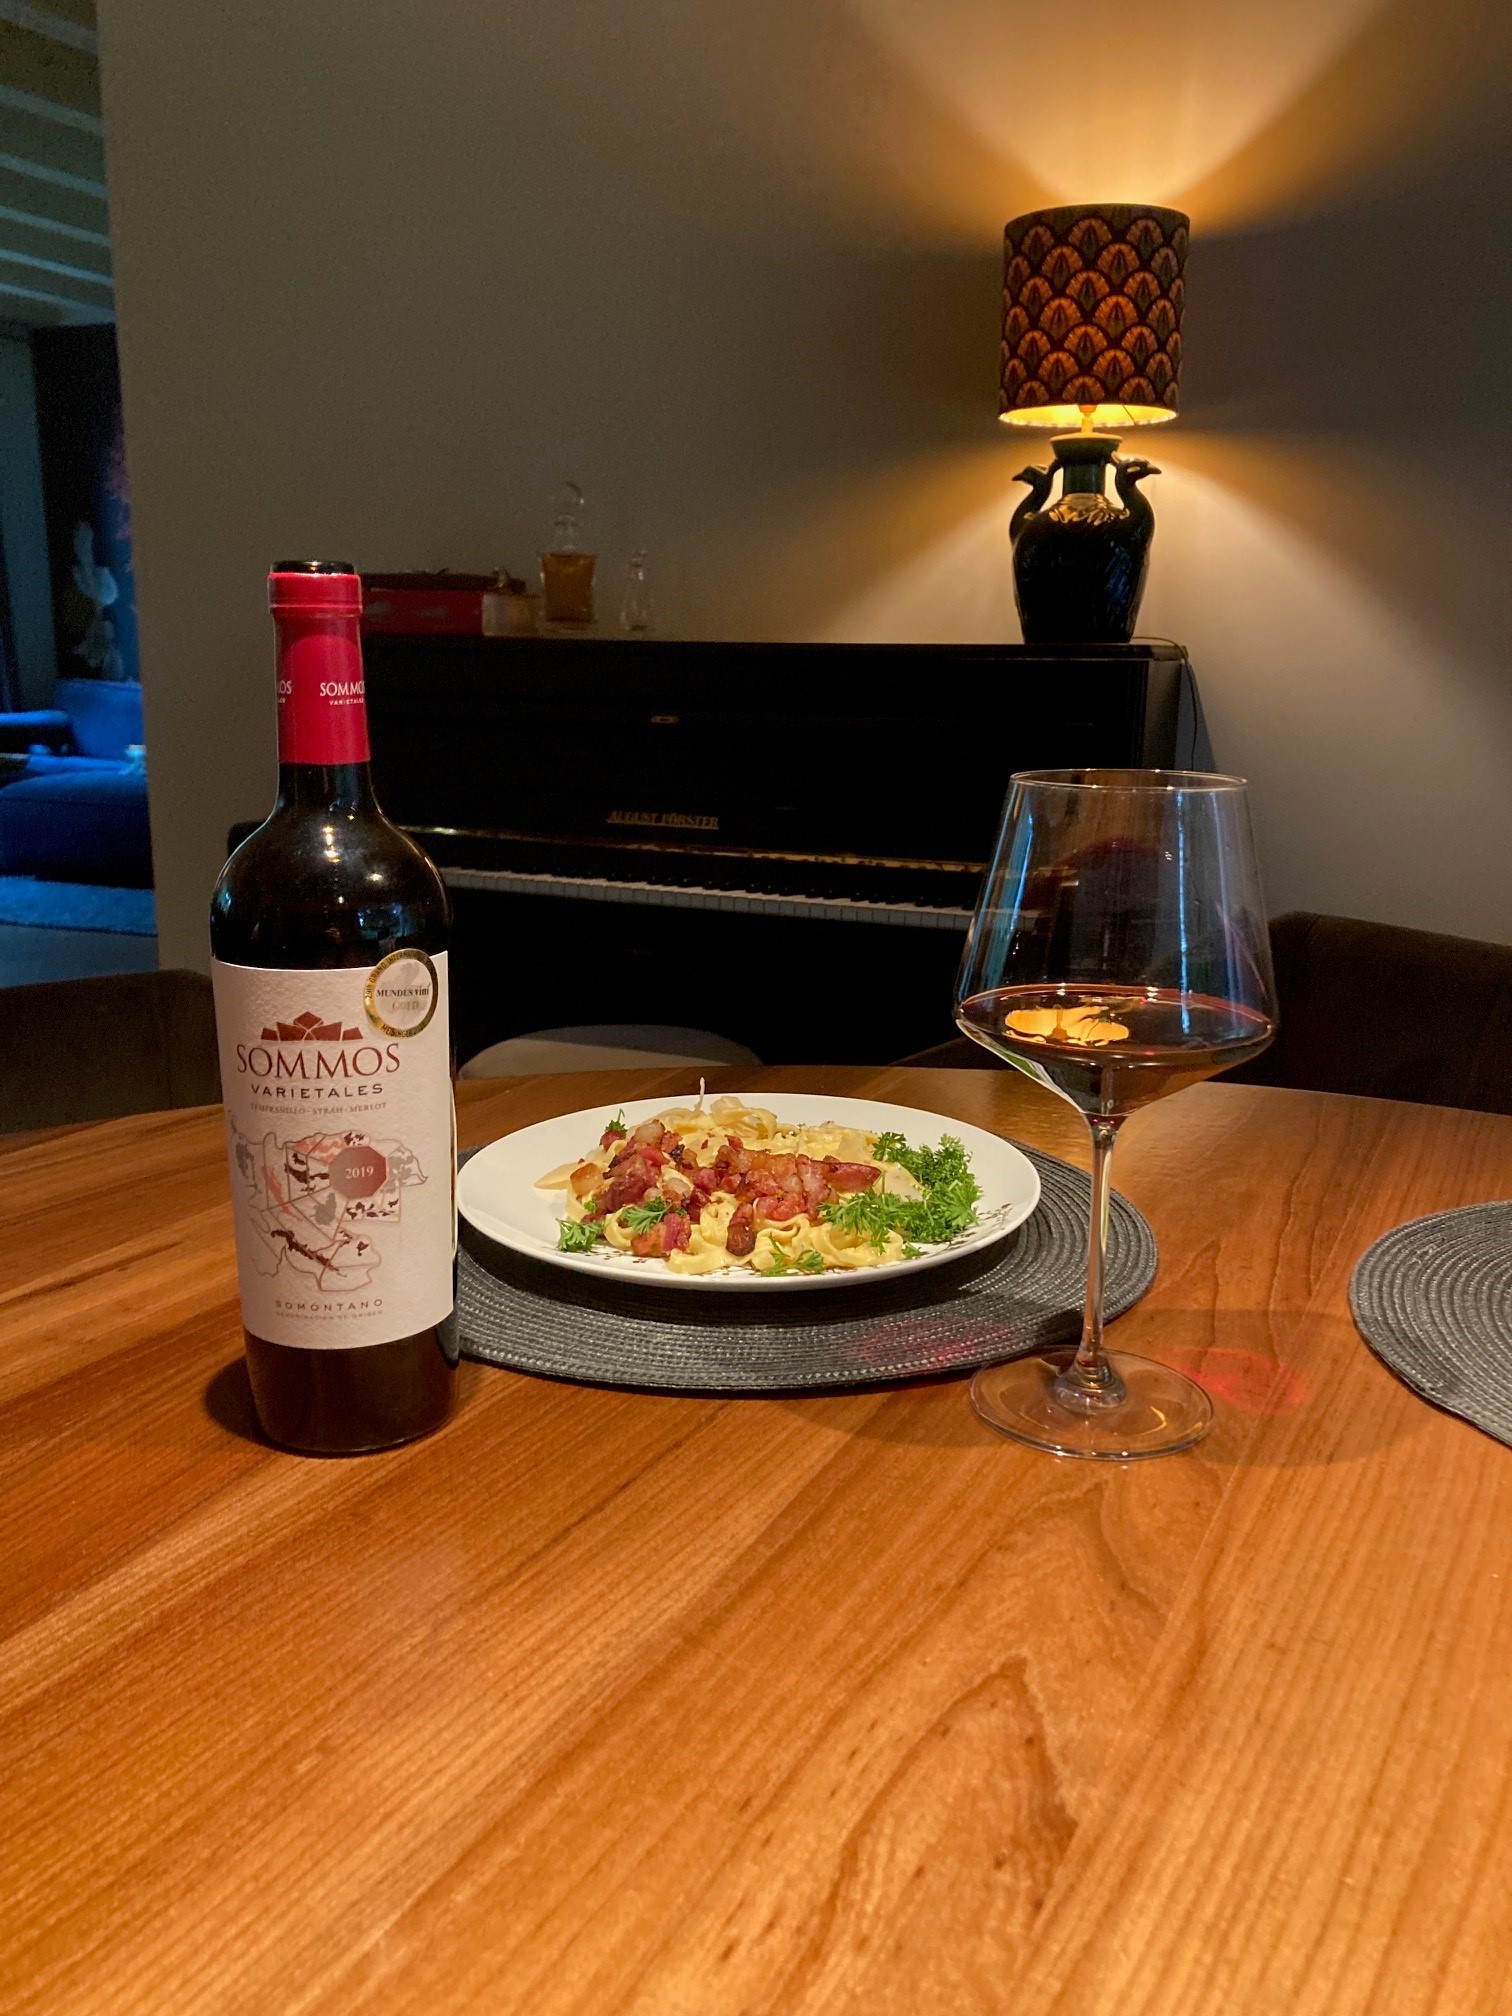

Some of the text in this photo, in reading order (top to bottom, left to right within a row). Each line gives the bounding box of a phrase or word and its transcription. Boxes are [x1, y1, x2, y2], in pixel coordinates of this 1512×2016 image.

[320, 680, 366, 697] SOMMO
[236, 1043, 401, 1080] SOMMOS
[251, 1083, 383, 1099] VARIETALES
[312, 1106, 344, 1115] SYRAH
[349, 1102, 387, 1113] MERLOT
[345, 1166, 374, 1179] 2019
[275, 1299, 383, 1312] SOMONTANO
